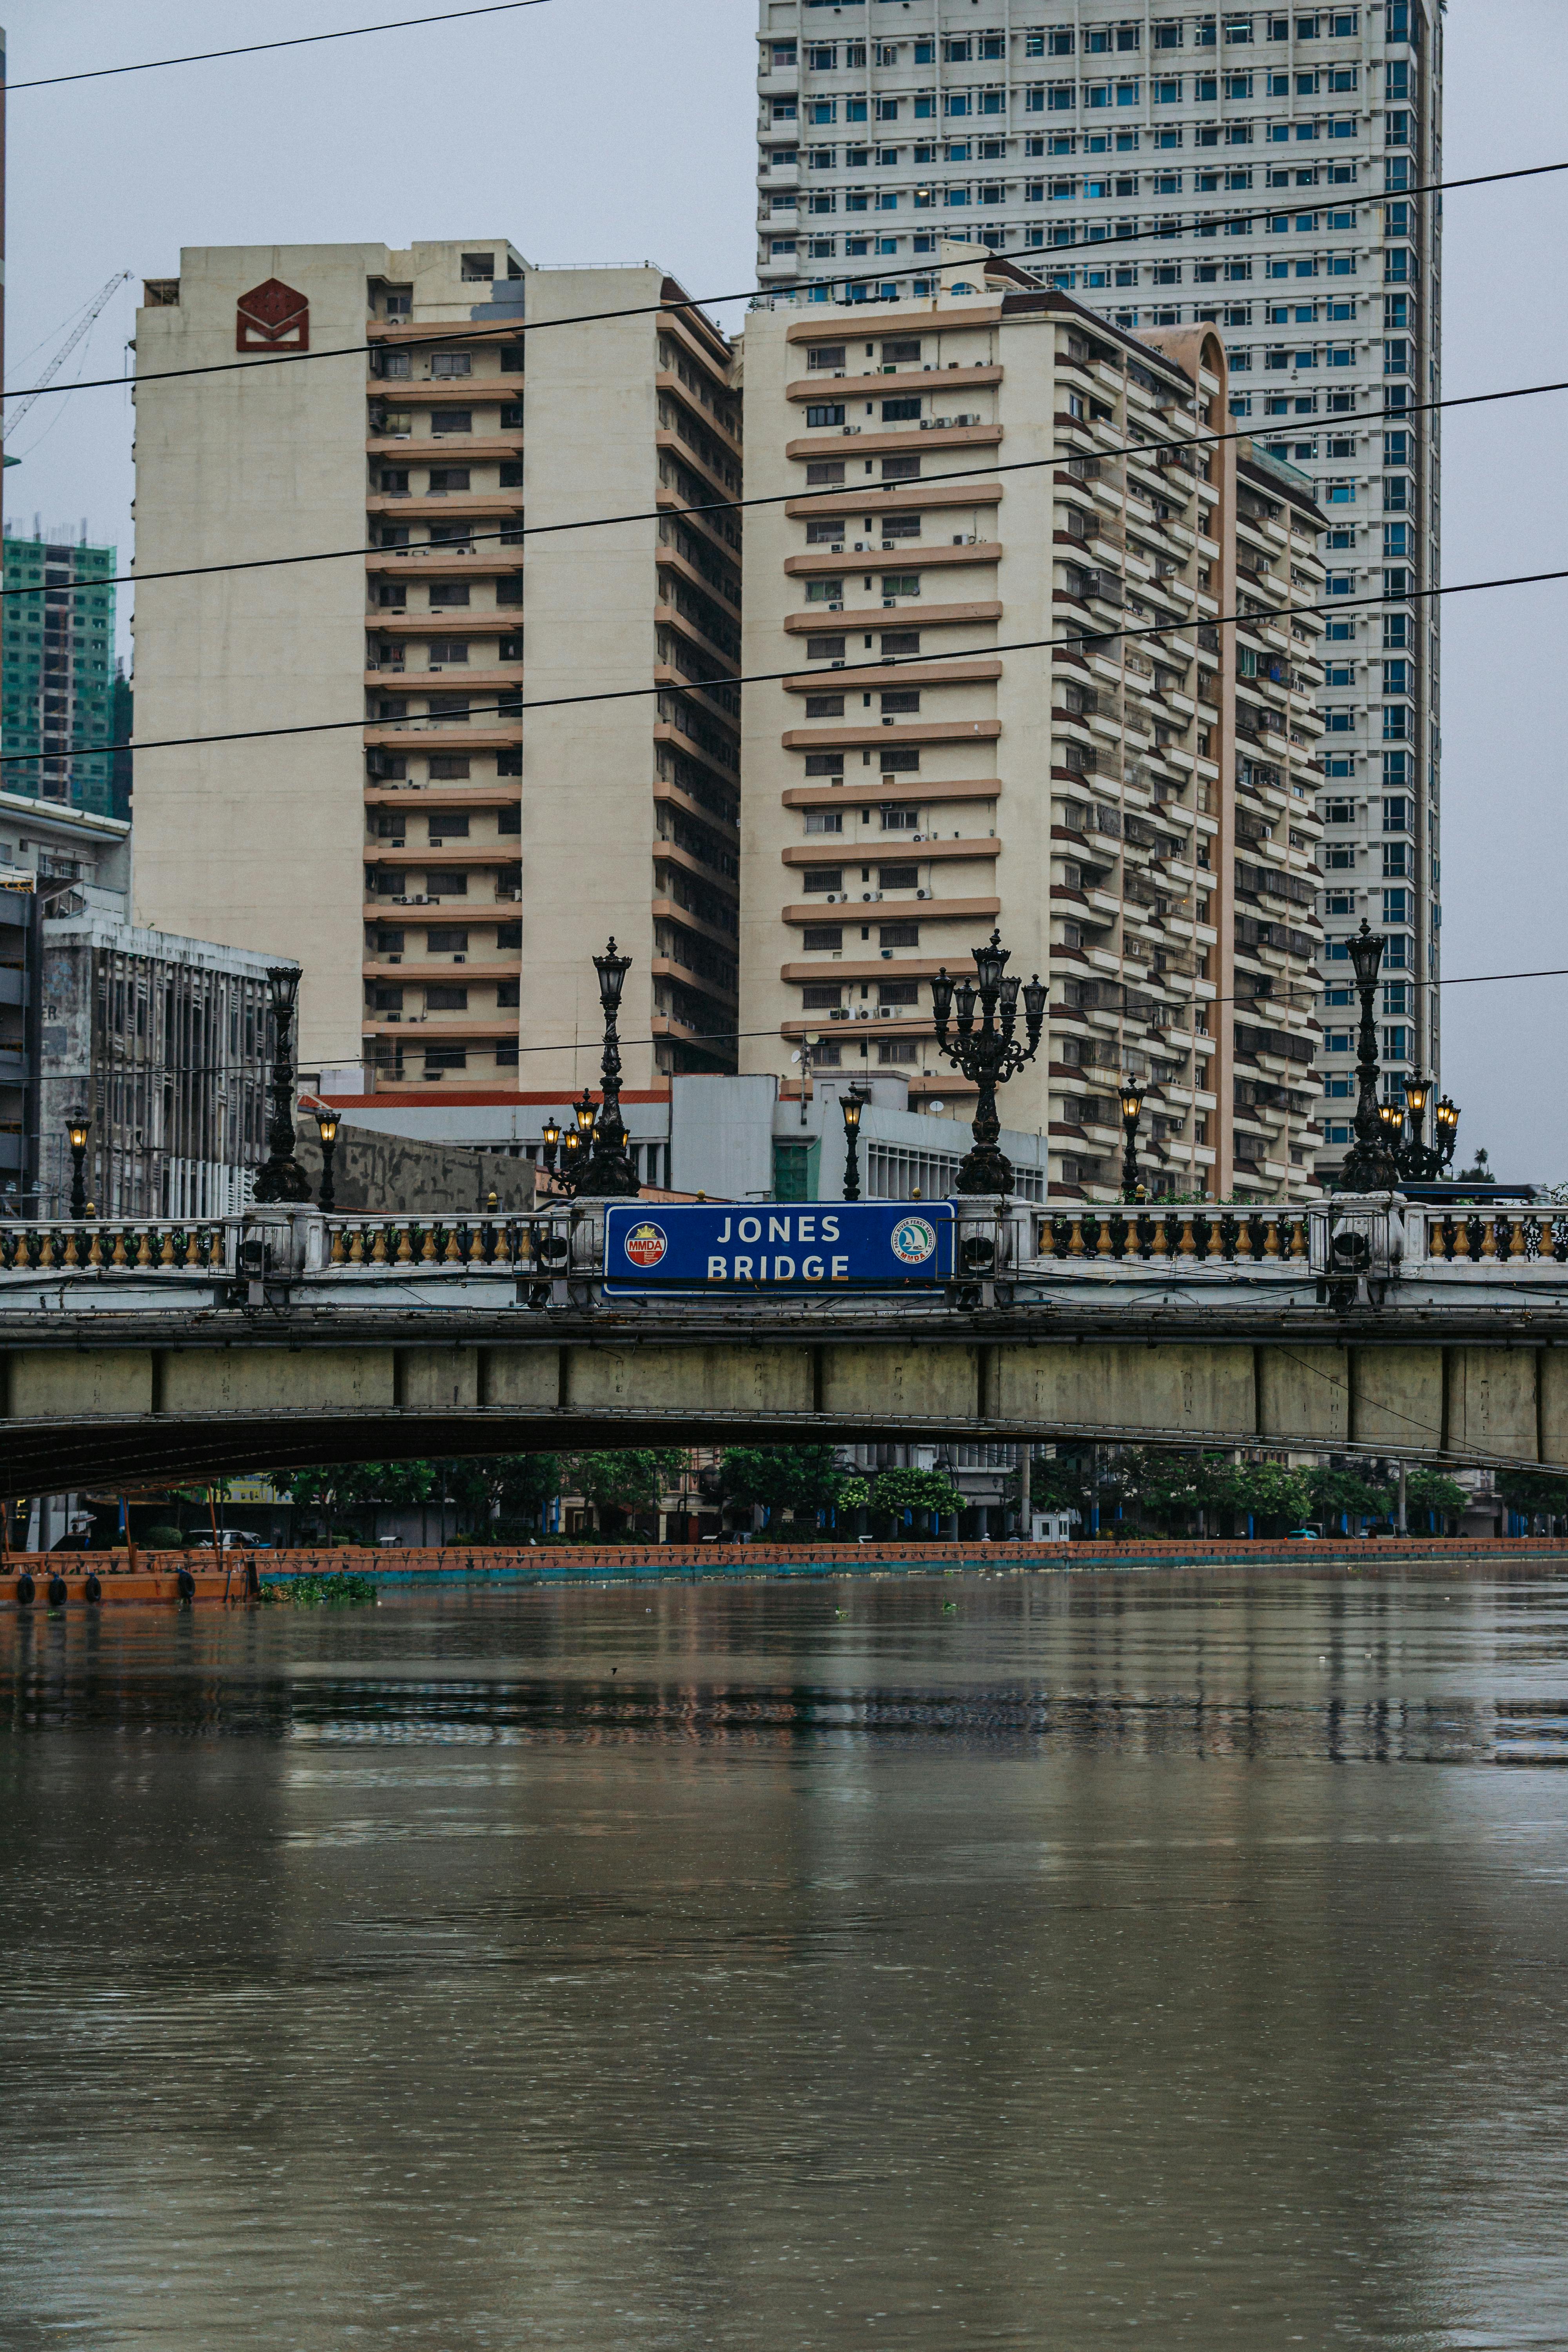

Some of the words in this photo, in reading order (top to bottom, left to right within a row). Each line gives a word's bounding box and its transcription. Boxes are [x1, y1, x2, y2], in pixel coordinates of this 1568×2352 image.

[717, 1216, 840, 1243] JONES
[897, 1221, 909, 1232] RIVER
[629, 1240, 662, 1250] MMDA
[900, 1252, 926, 1261] MMDA
[708, 1256, 849, 1281] BRIDGE
